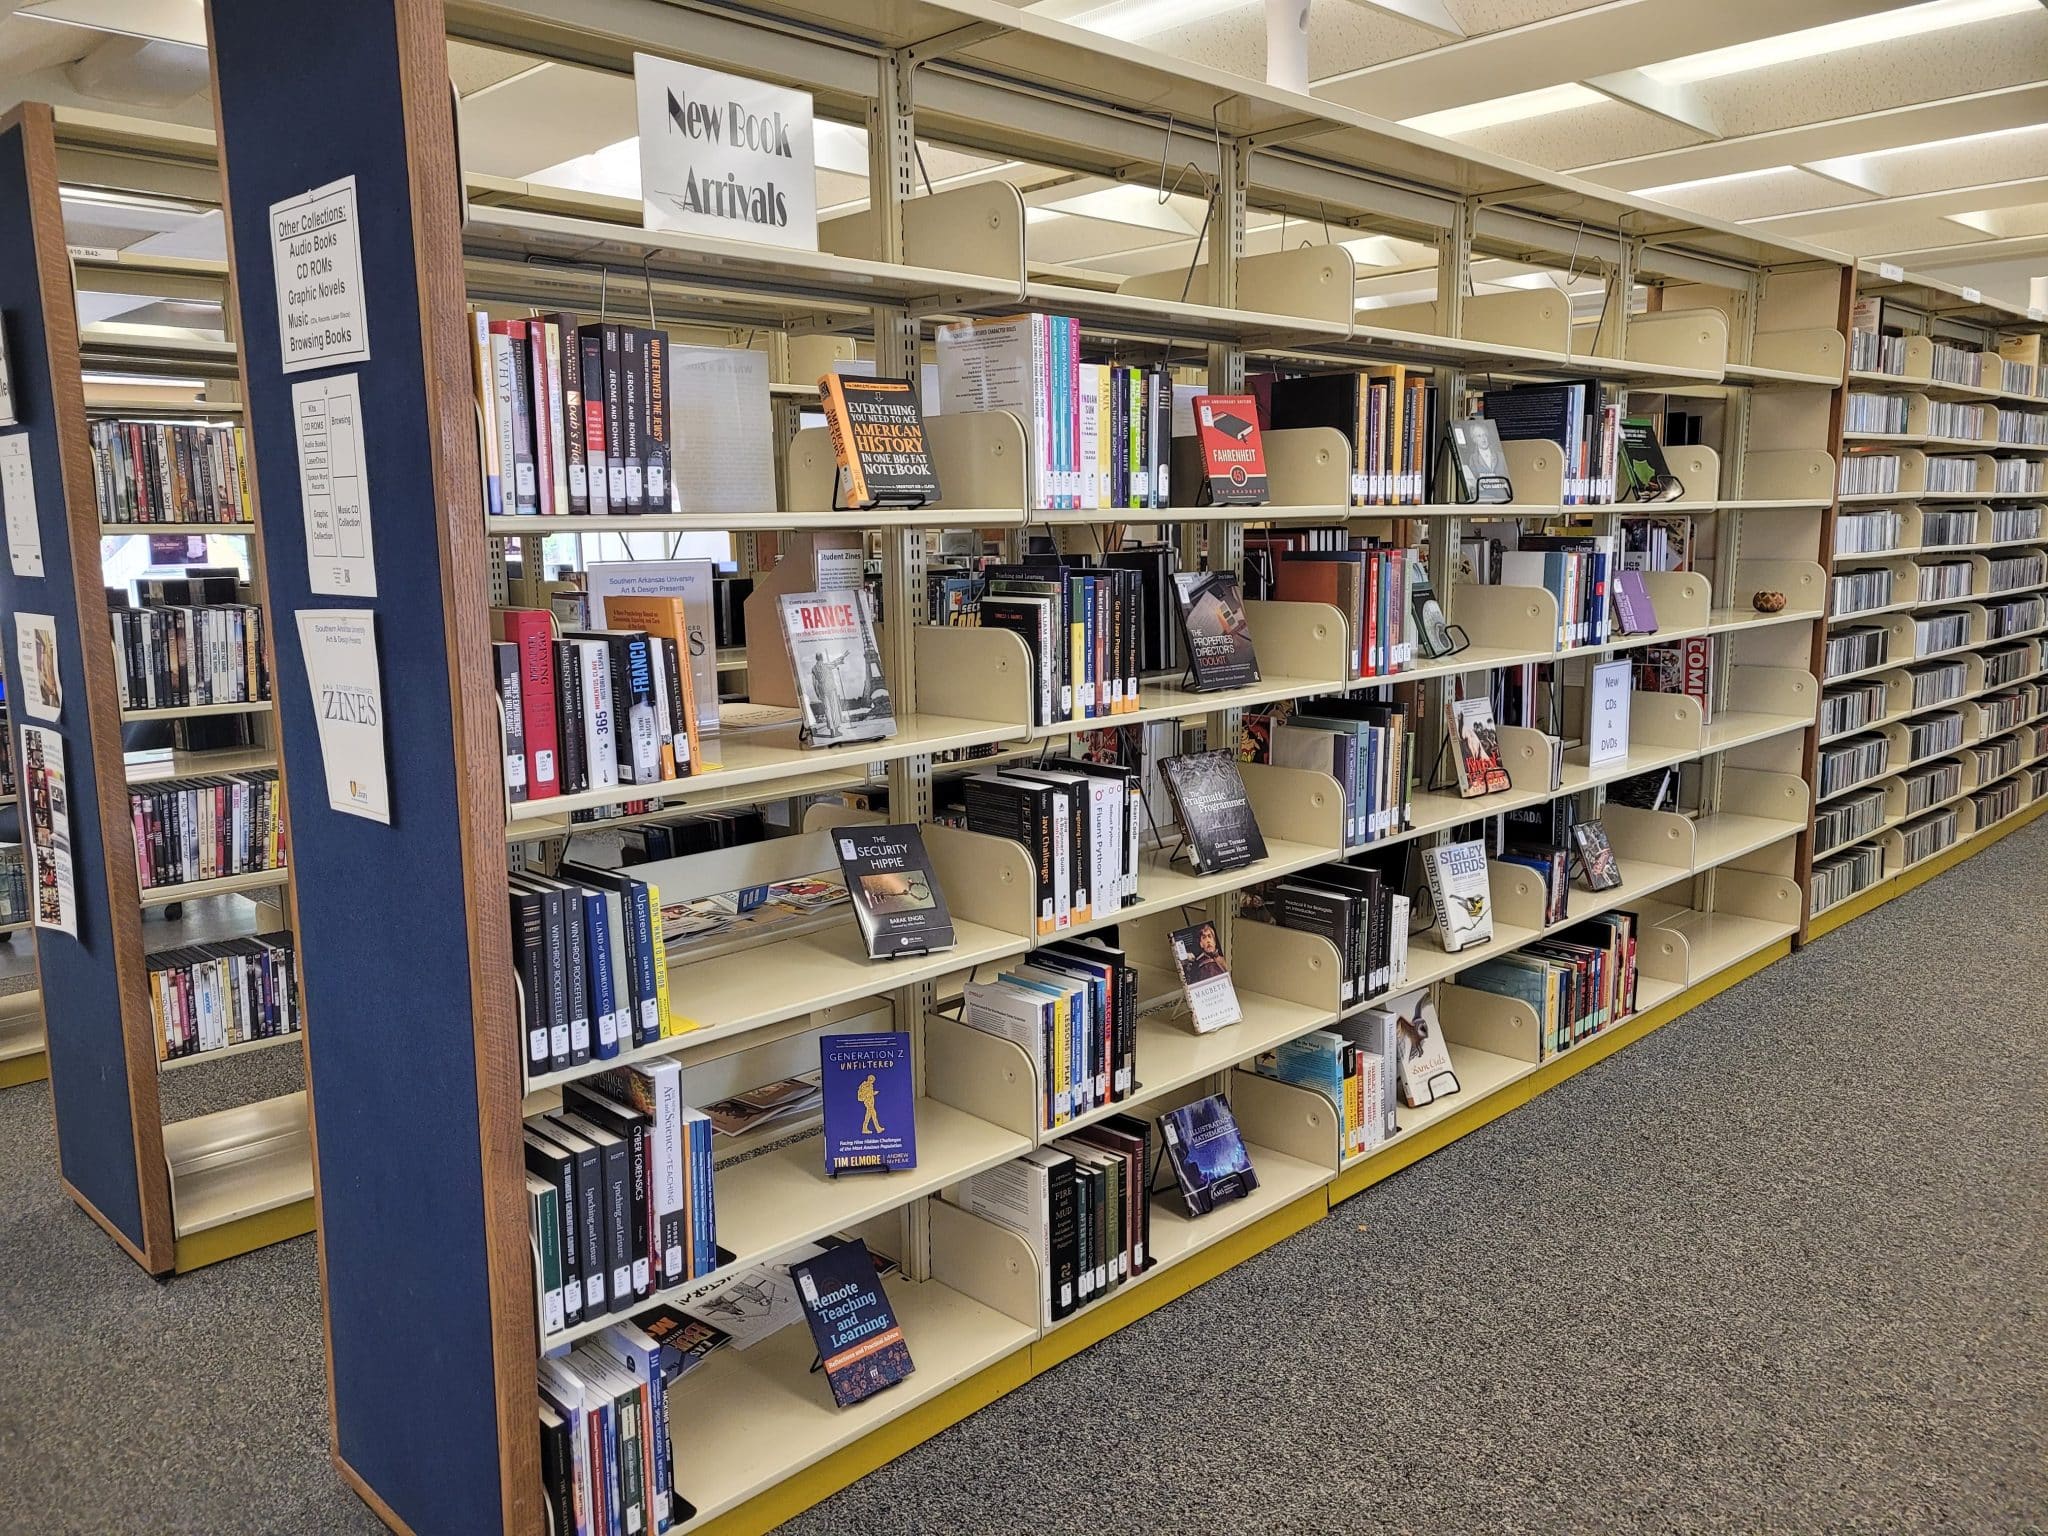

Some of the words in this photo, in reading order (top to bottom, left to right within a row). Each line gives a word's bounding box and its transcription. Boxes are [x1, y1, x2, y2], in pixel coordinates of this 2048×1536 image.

[667, 86, 723, 145] New
[729, 101, 792, 158] Book
[682, 165, 788, 227] Arrivals
[278, 219, 299, 238] Other
[301, 205, 346, 231] Collections:
[289, 239, 312, 258] Audio
[313, 232, 337, 250] Books
[296, 263, 309, 280] CD
[310, 258, 332, 277] ROMs
[288, 286, 317, 306] Graphic
[318, 279, 346, 298] Novels
[288, 313, 309, 329] Music
[290, 332, 324, 351] Browsing
[326, 328, 352, 346] Books
[651, 339, 661, 356] WHO
[1071, 336, 1079, 362] Century
[609, 369, 617, 403] JEROME
[626, 370, 635, 403] JEROME
[652, 359, 662, 399] BETRAYED
[653, 401, 662, 415] THE
[848, 402, 916, 416] EVERYTHING
[851, 413, 866, 422] YOU
[868, 415, 889, 423] NEED
[890, 416, 902, 424] TO
[903, 416, 918, 424] ACE
[331, 415, 351, 426] Browsing
[653, 416, 663, 442] JEWS?
[854, 423, 922, 437] AMERICAN
[611, 421, 620, 457] ROHWER
[629, 422, 637, 458] ROHWER
[856, 436, 923, 453] HISTORY
[861, 453, 872, 463] IN
[873, 453, 891, 463] ONE
[893, 454, 909, 464] BIG
[910, 454, 928, 464] FAT
[1212, 448, 1256, 463] FAHRENHEIT
[863, 463, 932, 476] NOTEBOOK
[337, 505, 350, 514] Music
[350, 505, 359, 514] CD
[338, 517, 361, 527] Collection
[821, 552, 844, 561] Student
[844, 552, 861, 560] Zines
[609, 577, 637, 585] Southern
[637, 576, 665, 584] Arkansas
[666, 574, 695, 584] University
[637, 585, 657, 594] Design
[659, 584, 685, 592] Presents
[1114, 600, 1121, 609] Go
[1041, 602, 1049, 636] WILLIAM
[1190, 629, 1203, 637] THE
[1192, 635, 1234, 646] PROPERTIES
[538, 631, 550, 686] DEFYING
[1195, 645, 1235, 657] DIRECTOR'S
[1199, 655, 1227, 667] TOOLKIT
[561, 645, 571, 689] MEMENTO
[628, 641, 650, 693] FRANCO
[1605, 675, 1619, 688] New
[322, 690, 377, 726] ZINES
[565, 690, 573, 714] MORI
[1604, 698, 1617, 711] CDs
[596, 711, 609, 734] 365
[1608, 720, 1613, 729] &
[1601, 739, 1618, 751] DVDs
[1182, 791, 1227, 807] Pragmatic
[1198, 798, 1246, 813] Programmer
[1041, 815, 1049, 835] Java
[1095, 807, 1103, 838] Fluent
[872, 835, 887, 844] THE
[857, 843, 908, 858] SECURITY
[1040, 836, 1050, 885] Challenges
[1094, 841, 1104, 877] Python
[1440, 845, 1483, 865] SIBLEY
[870, 857, 905, 869] HIPPIE
[1450, 858, 1486, 876] BIRDS
[1425, 854, 1442, 896] SIBLEY
[635, 893, 649, 944] Upstream
[571, 921, 582, 964] WINTHROP
[595, 921, 605, 946] LAND
[551, 924, 562, 969] WINTHROP
[642, 955, 650, 972] DAN
[656, 957, 664, 969] DIE
[598, 952, 609, 998] WONDROUS
[643, 973, 652, 992] HEATH
[657, 970, 665, 989] POOR
[552, 970, 564, 1025] ROCKEFELLER
[573, 966, 583, 1019] ROCKEFELLER
[1194, 982, 1227, 999] MACBETH
[829, 1049, 894, 1061] GENERATION
[897, 1049, 905, 1058] Z
[840, 1060, 895, 1071] UNFILTERED
[665, 1113, 677, 1152] Science
[1189, 1115, 1232, 1137] ILLUSTRATING
[1191, 1123, 1234, 1142] MATHEMATICS
[633, 1125, 644, 1153] CYBER
[833, 1156, 848, 1168] TIM
[850, 1154, 881, 1167] ELMORE
[635, 1154, 645, 1201] FORENSICS
[666, 1159, 675, 1205] TEACHING
[584, 1187, 598, 1225] Lynching
[613, 1180, 625, 1218] Lynching
[616, 1217, 624, 1231] and
[589, 1237, 599, 1267] Leisure
[617, 1230, 626, 1259] Leisure
[812, 1282, 859, 1311] Remote
[818, 1291, 877, 1324] Teaching
[830, 1313, 890, 1348] Learning:
[836, 1315, 860, 1332] and
